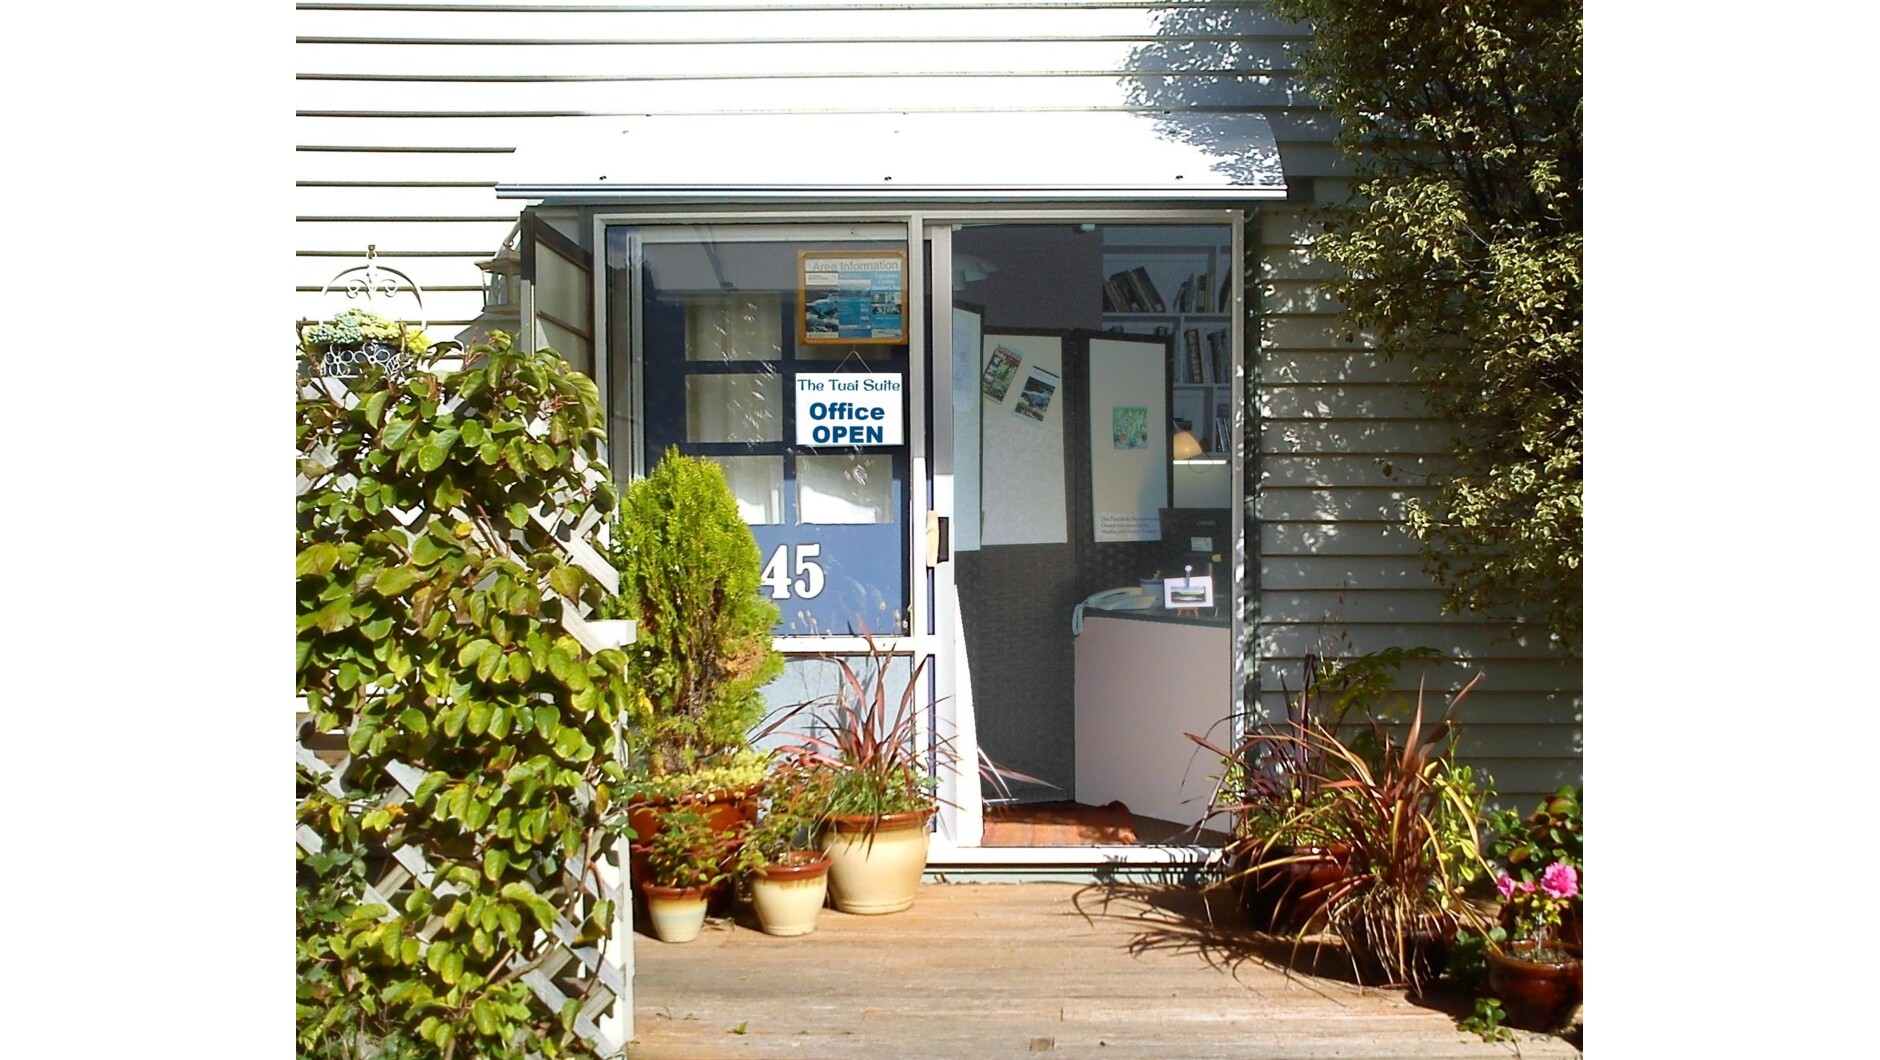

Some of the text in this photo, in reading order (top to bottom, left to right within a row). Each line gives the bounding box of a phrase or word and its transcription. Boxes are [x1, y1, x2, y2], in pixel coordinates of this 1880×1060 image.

[812, 260, 899, 272] Area Information
[797, 378, 901, 391] The Tuai Suite
[809, 402, 885, 421] Office
[812, 425, 884, 444] OPEN
[760, 544, 825, 600] 45
